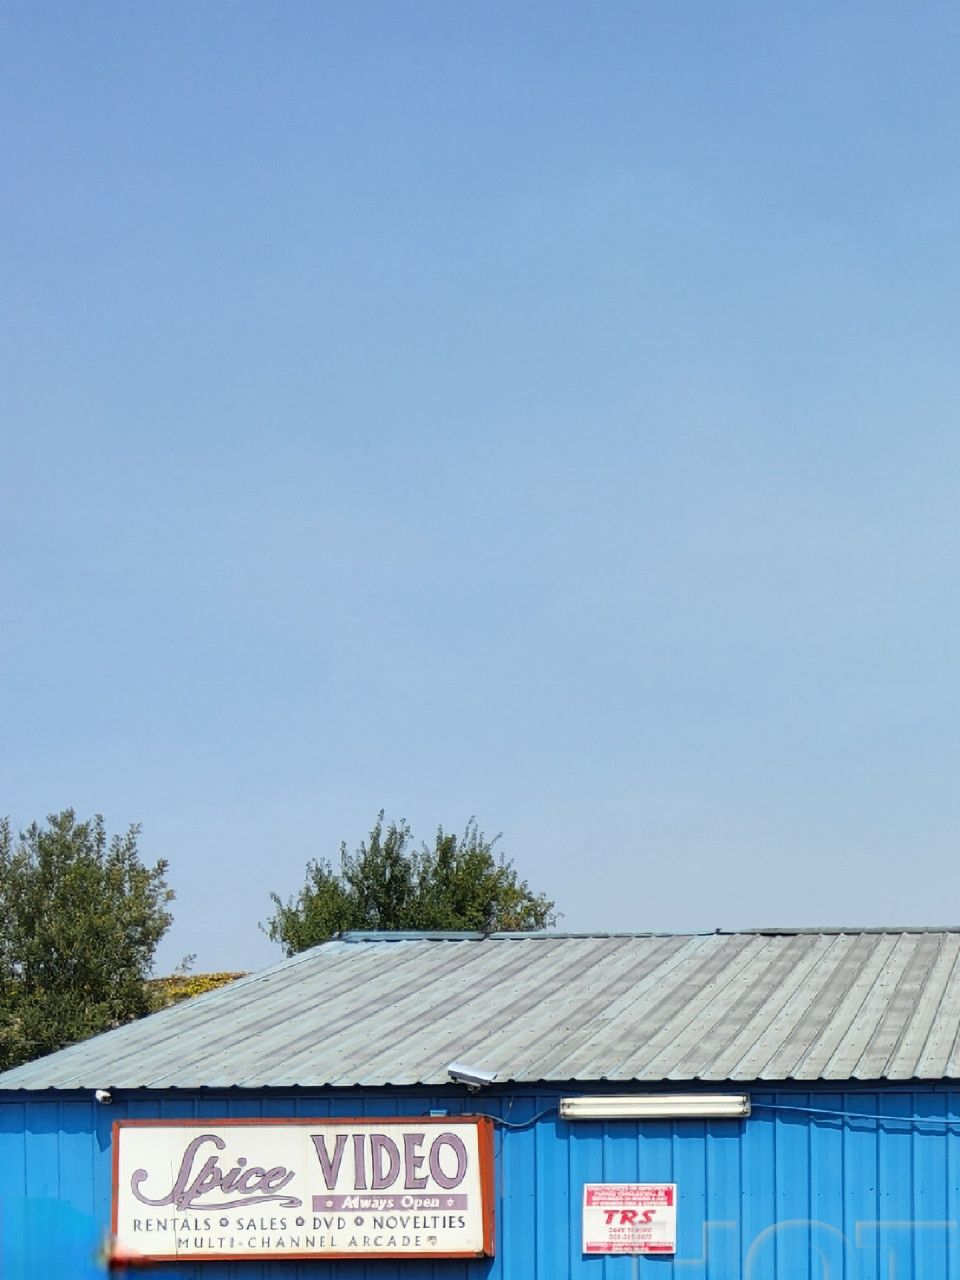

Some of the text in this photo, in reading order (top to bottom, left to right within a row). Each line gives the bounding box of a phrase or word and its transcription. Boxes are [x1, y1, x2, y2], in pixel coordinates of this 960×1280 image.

[130, 1132, 468, 1211] Spice VIDEO
[341, 1196, 440, 1210] Always Open
[133, 1215, 466, 1231] RENTALS SALES DVD NOVELTIES
[603, 1209, 657, 1225] TRS
[177, 1235, 422, 1249] MULTI-CHANNEL ARCADE
